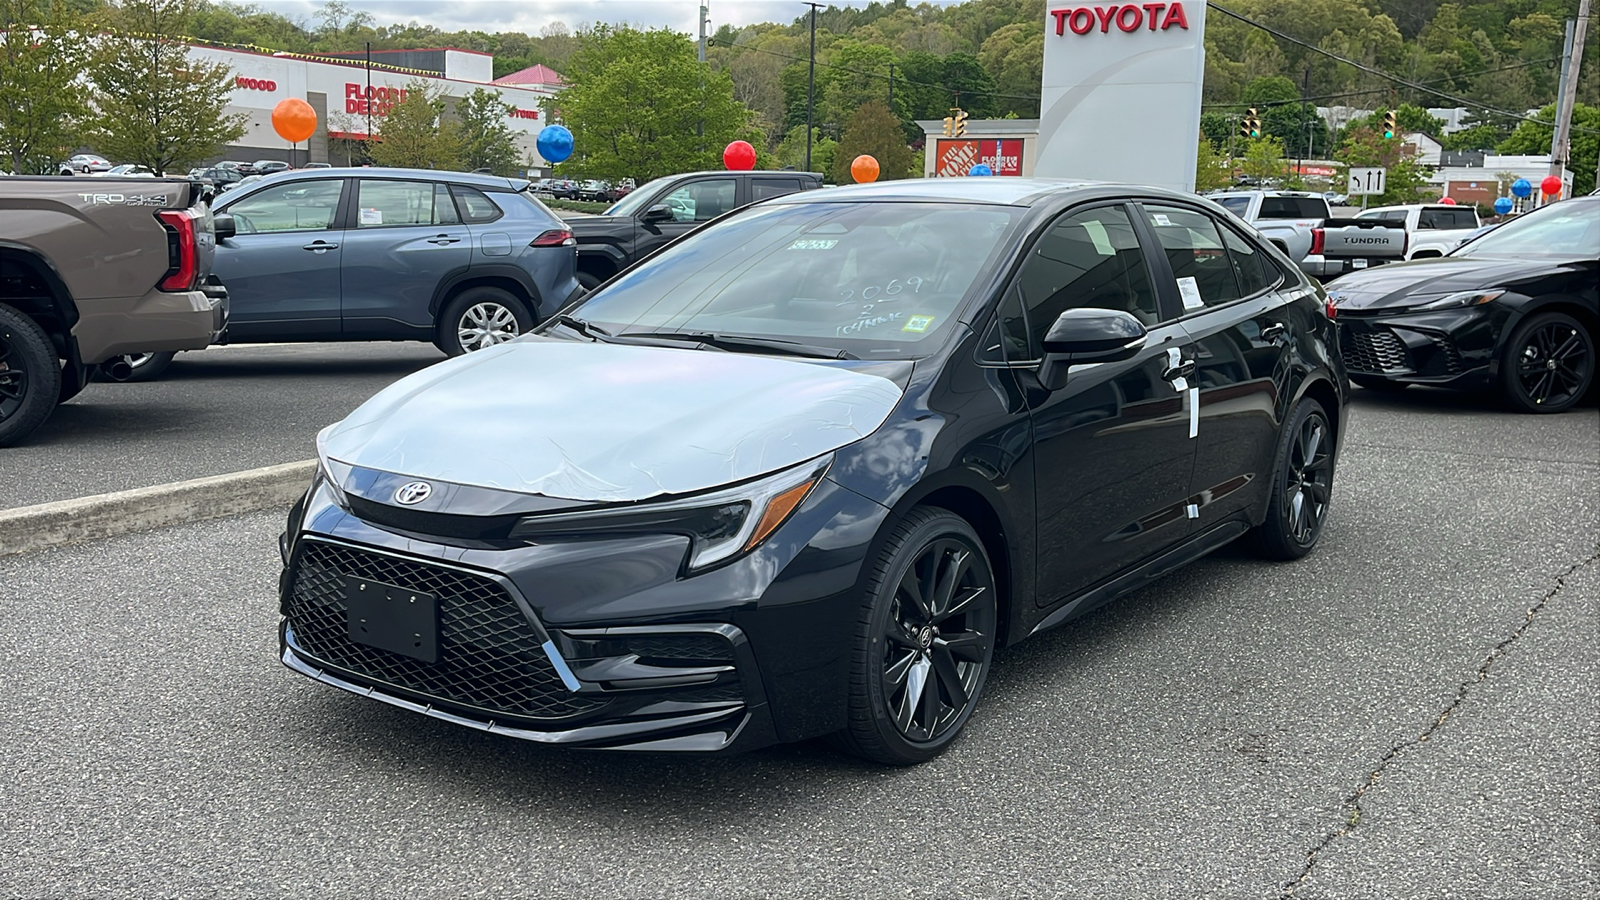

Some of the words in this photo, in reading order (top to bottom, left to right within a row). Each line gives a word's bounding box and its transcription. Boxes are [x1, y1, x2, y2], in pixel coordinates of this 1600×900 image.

[1050, 2, 1189, 36] TOYOTA
[235, 77, 277, 92] WOOD
[345, 98, 395, 117] DECO
[941, 144, 959, 164] THE
[77, 193, 125, 205] TRD
[1343, 237, 1390, 245] TUNDRA
[836, 276, 923, 307] 2069
